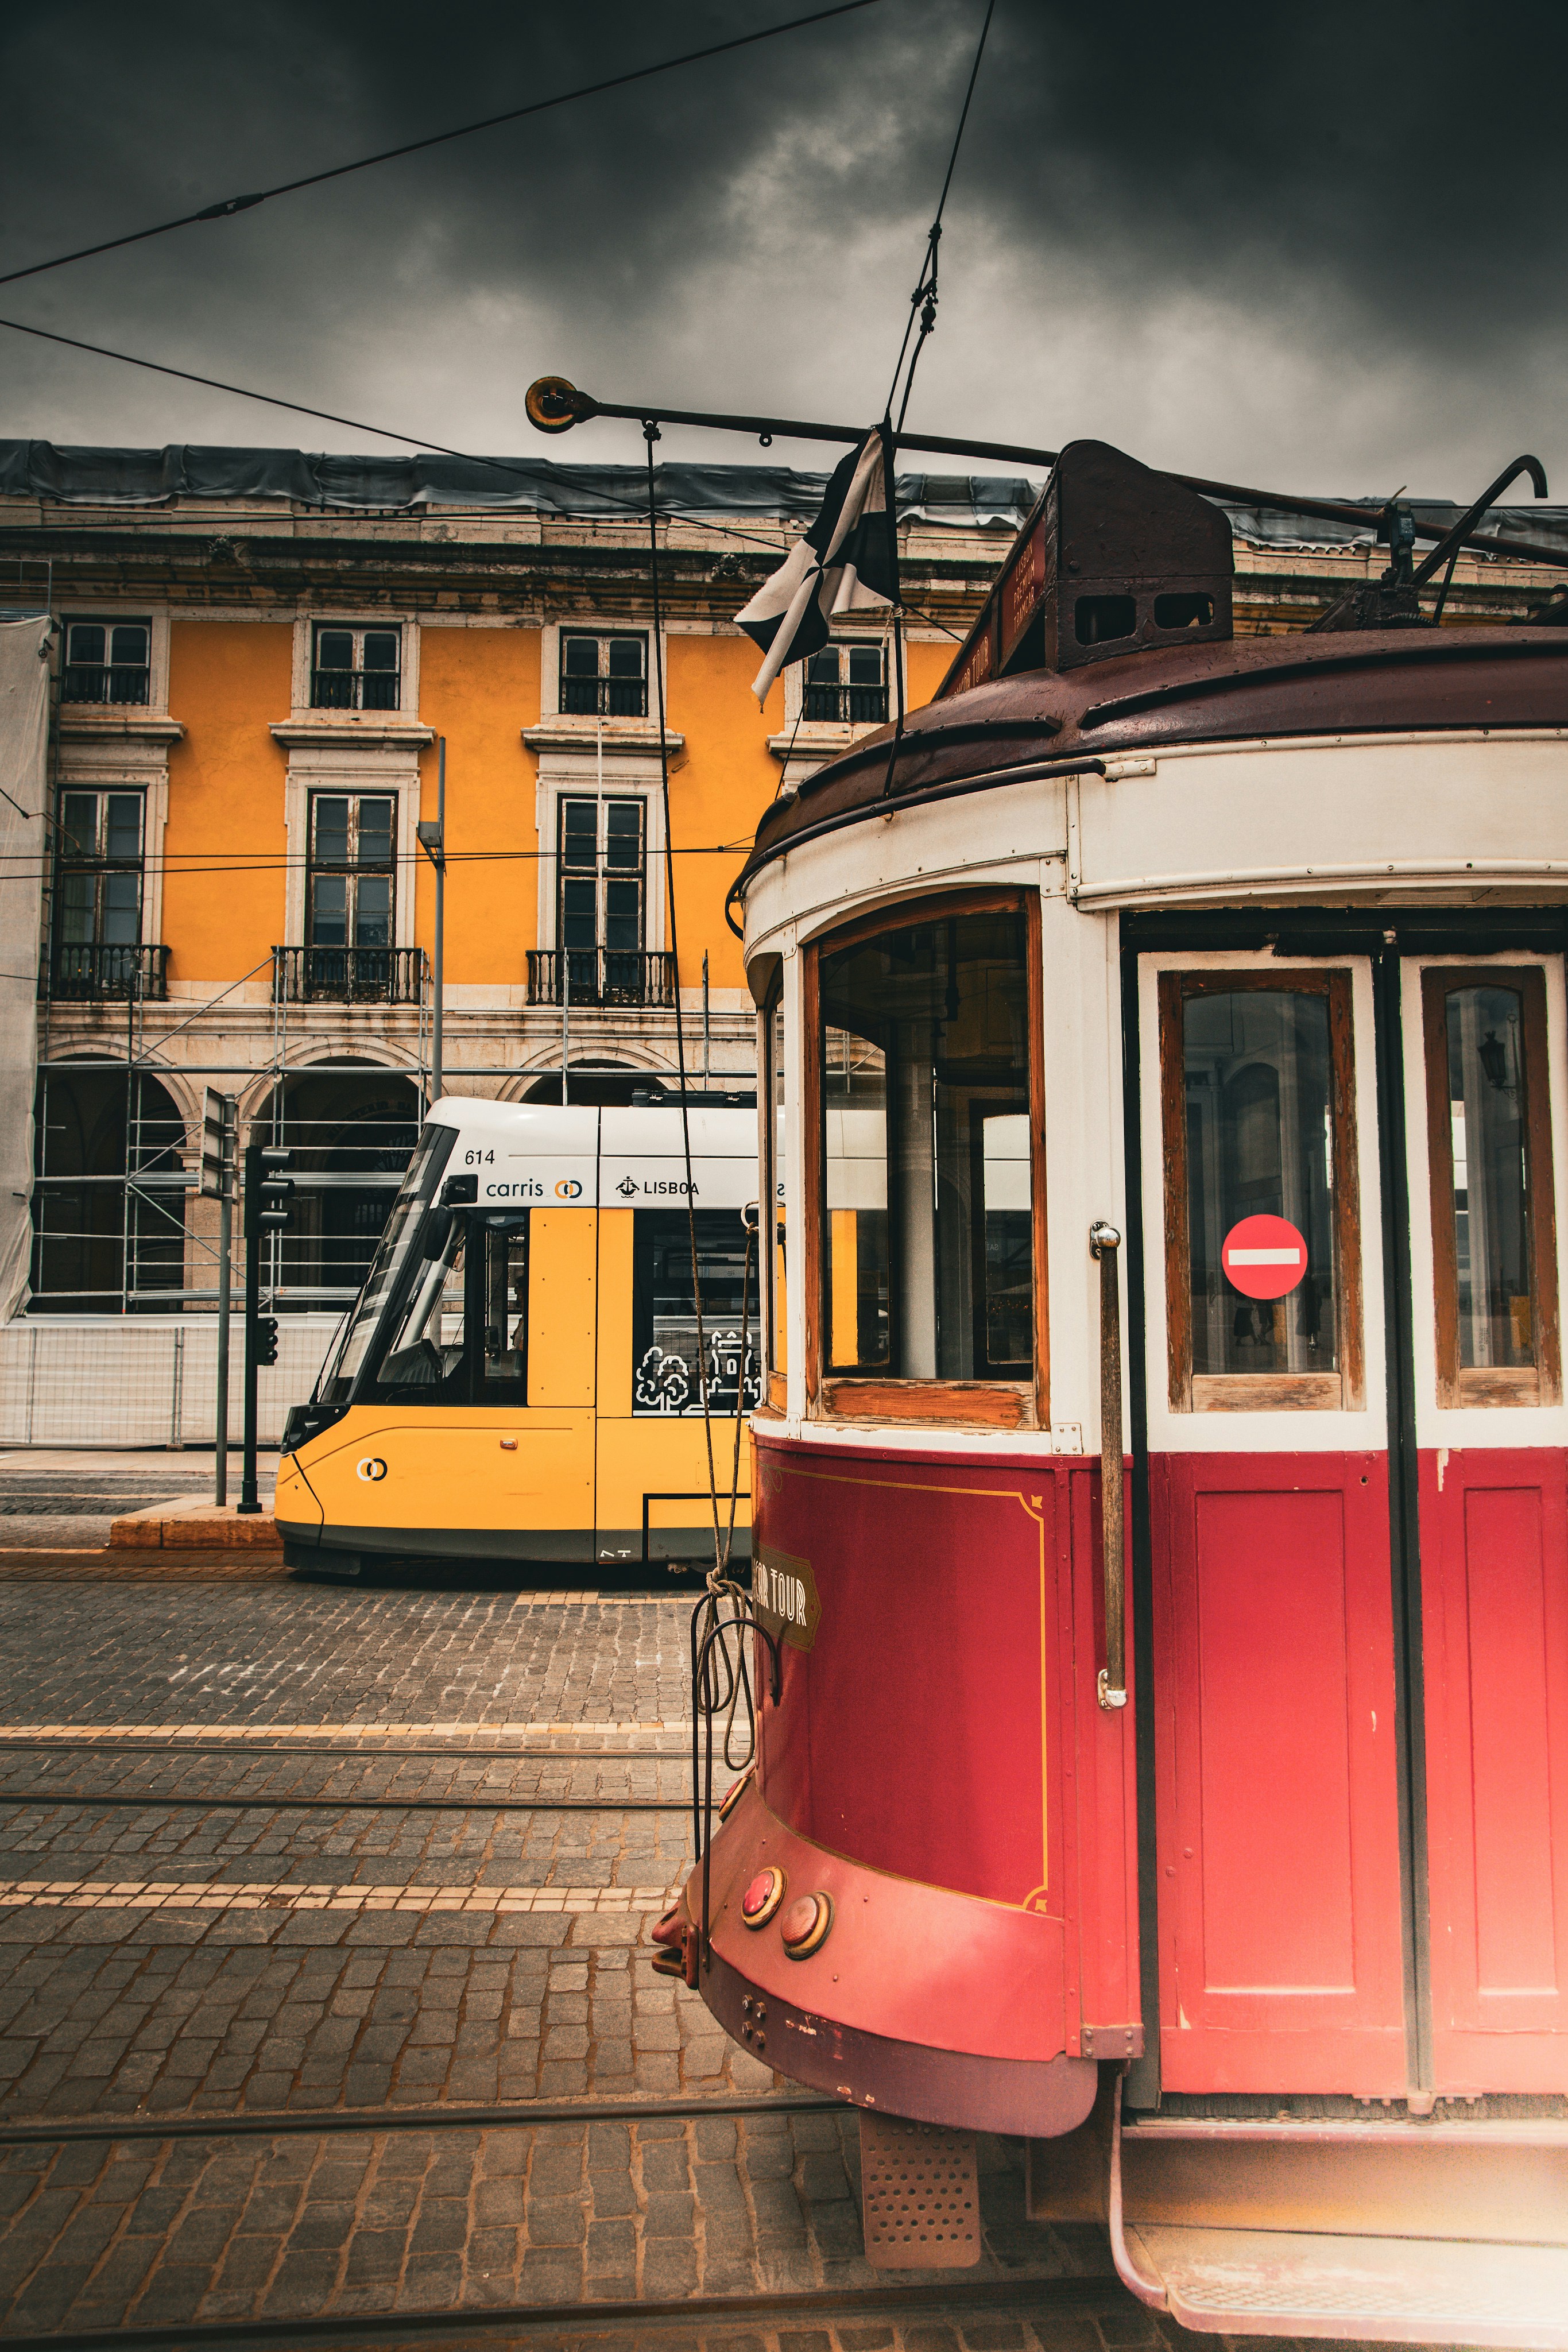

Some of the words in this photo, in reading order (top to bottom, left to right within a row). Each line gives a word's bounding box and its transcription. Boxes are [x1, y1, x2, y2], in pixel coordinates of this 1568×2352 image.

[1016, 538, 1033, 582] LISBON
[1013, 559, 1035, 610] PREMIUM
[1013, 586, 1035, 633] TRAMCAR
[972, 636, 989, 687] TOUR
[464, 1150, 495, 1165] 614
[486, 1178, 543, 1197] carris
[644, 1181, 700, 1195] LISBOA
[770, 1568, 807, 1626] TOUR
